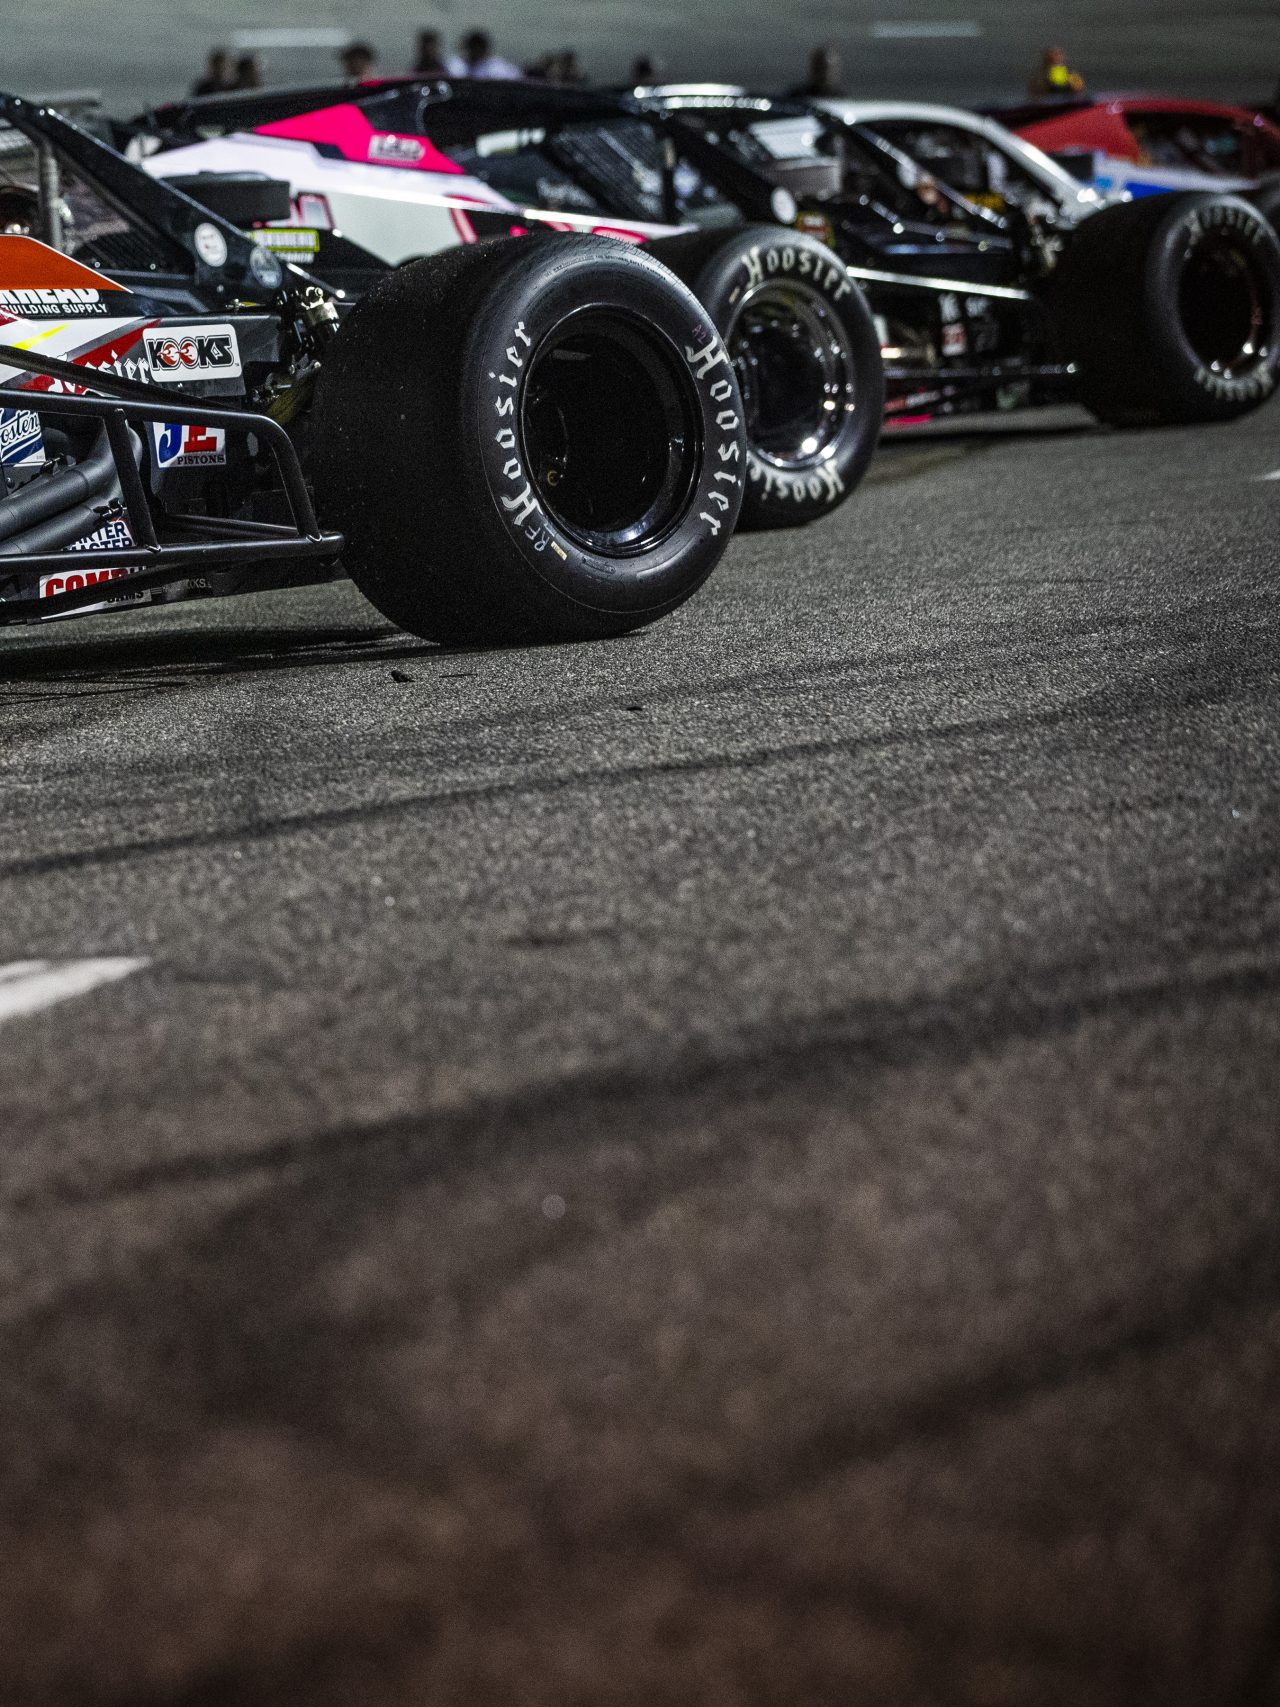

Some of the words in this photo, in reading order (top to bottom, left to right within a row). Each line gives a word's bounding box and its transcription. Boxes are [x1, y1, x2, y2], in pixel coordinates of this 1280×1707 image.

[741, 246, 852, 301] Hoosier
[62, 304, 108, 314] SUPPLY
[146, 335, 234, 371] KOOKS
[488, 321, 545, 526] Hoosier
[685, 335, 742, 536] Hoosier
[177, 454, 225, 465] PISTONS
[746, 458, 845, 501] Hoosie
